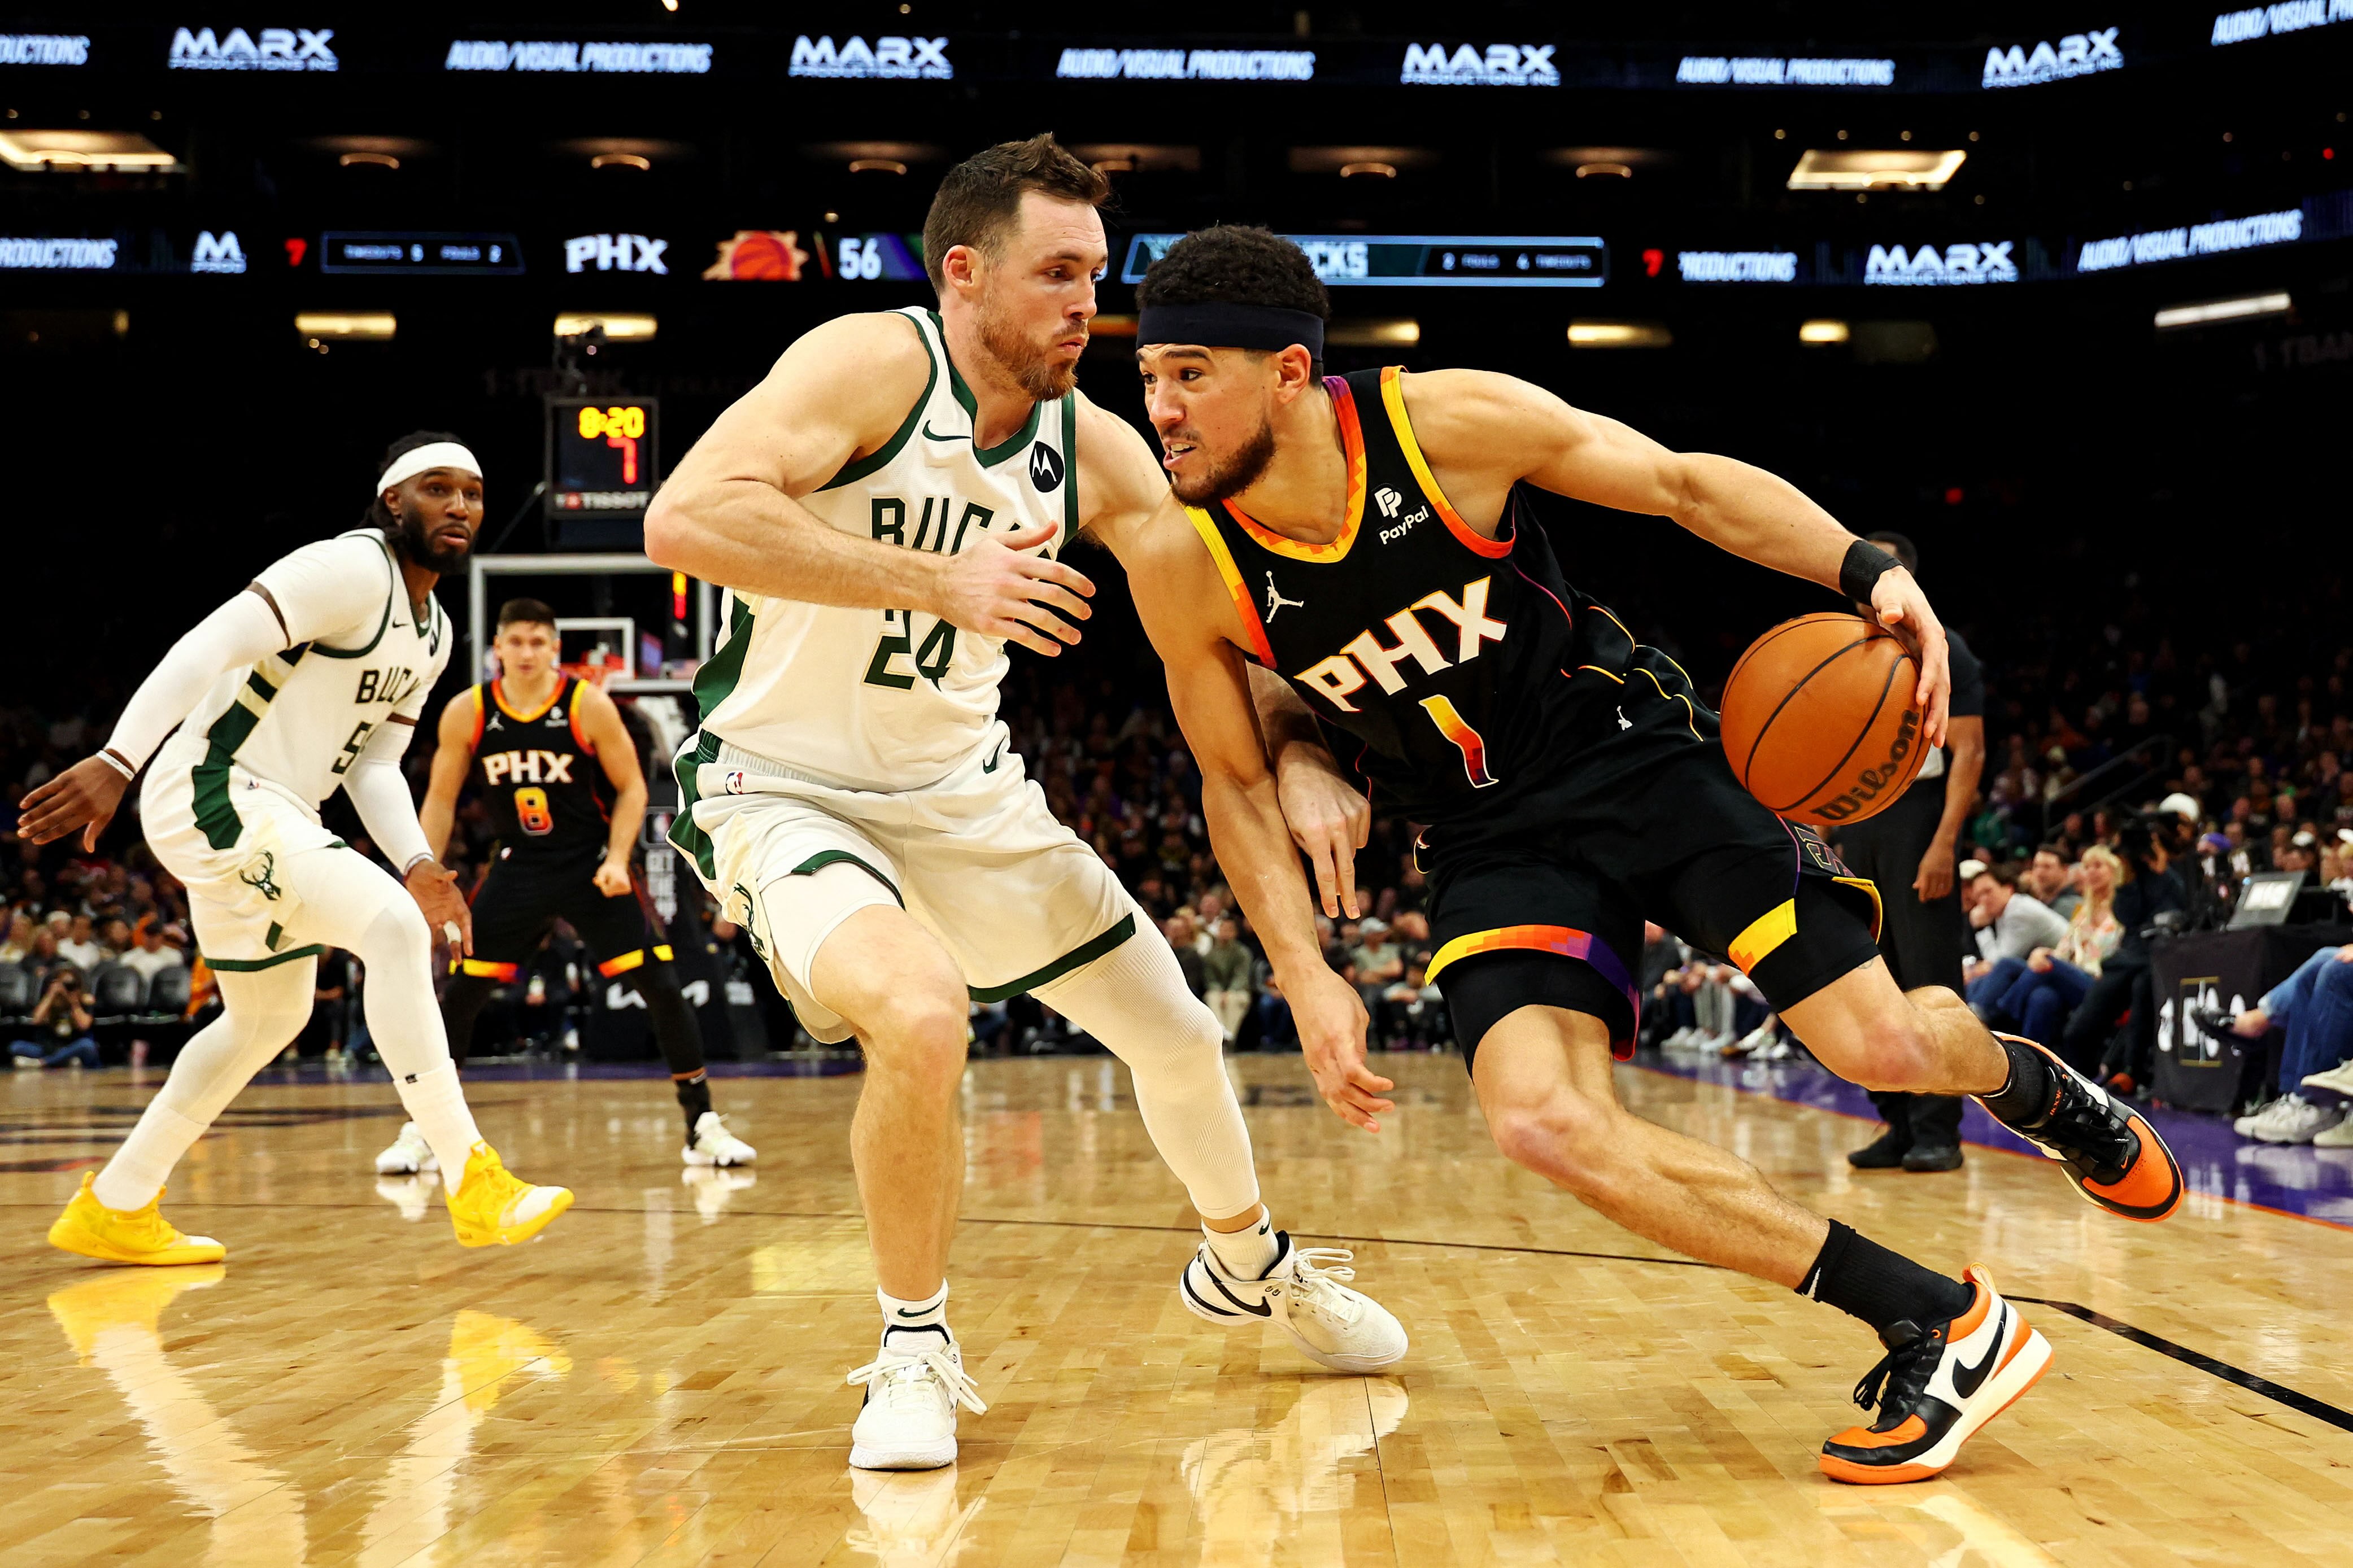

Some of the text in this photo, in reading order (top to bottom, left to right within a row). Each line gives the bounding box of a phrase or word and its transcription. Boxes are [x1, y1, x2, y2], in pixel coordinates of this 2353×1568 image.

[170, 27, 336, 58] MARX
[579, 42, 713, 73] PRODUCTIONS
[791, 35, 951, 66] MARX
[1402, 43, 1558, 74] MARX
[1984, 27, 2122, 77] MARX
[1186, 50, 1315, 80] PRODUCTIONS
[1785, 58, 1896, 86] PRODUCTIONS
[285, 238, 307, 266] 7
[2188, 208, 2304, 256] PRODUCTIONS
[565, 233, 669, 275] PHX
[839, 238, 882, 280] 56
[1642, 248, 1664, 277] 7
[1866, 241, 2017, 275] MARX
[579, 407, 644, 439] 8:20
[607, 436, 637, 484] 7
[870, 496, 1011, 556] BUC
[1379, 505, 1430, 545] PayPal
[863, 609, 958, 692] 24
[1293, 575, 1507, 713] PHX
[1418, 694, 1500, 788] 1
[482, 749, 574, 786] PHX
[1809, 709, 1920, 820] Wilson
[513, 787, 554, 836] 8
